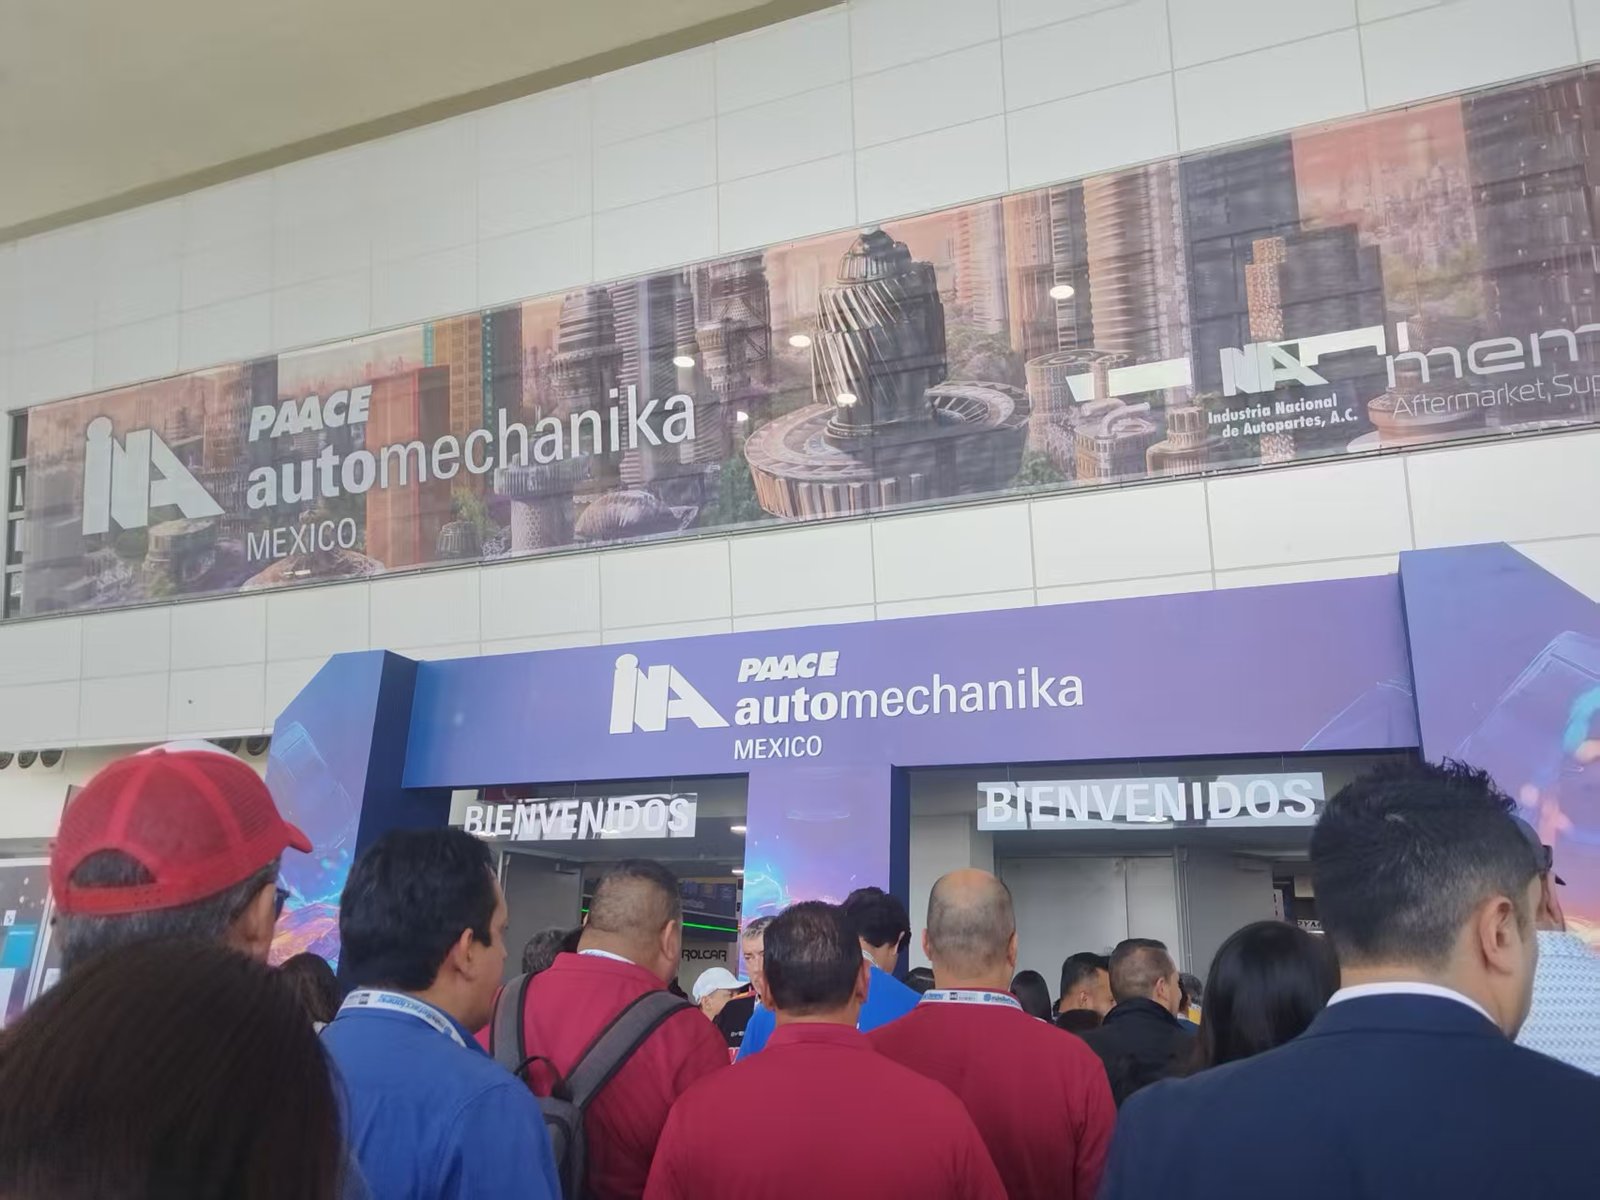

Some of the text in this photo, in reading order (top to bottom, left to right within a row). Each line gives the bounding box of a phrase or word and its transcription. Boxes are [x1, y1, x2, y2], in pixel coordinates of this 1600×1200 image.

[249, 385, 373, 441] PAACE
[1208, 393, 1337, 424] Industria Nacional
[1222, 408, 1358, 438] de Autopartes, A.C.
[246, 387, 697, 509] automechanika
[246, 517, 358, 563] MEXICO
[737, 650, 840, 683] PAACE
[735, 667, 1085, 726] automechanika
[734, 735, 822, 760] MEXICO
[464, 798, 690, 836] BIENVENIDOS
[986, 778, 1317, 824] BIENVENIDOS
[681, 949, 727, 962] ROLCAR
